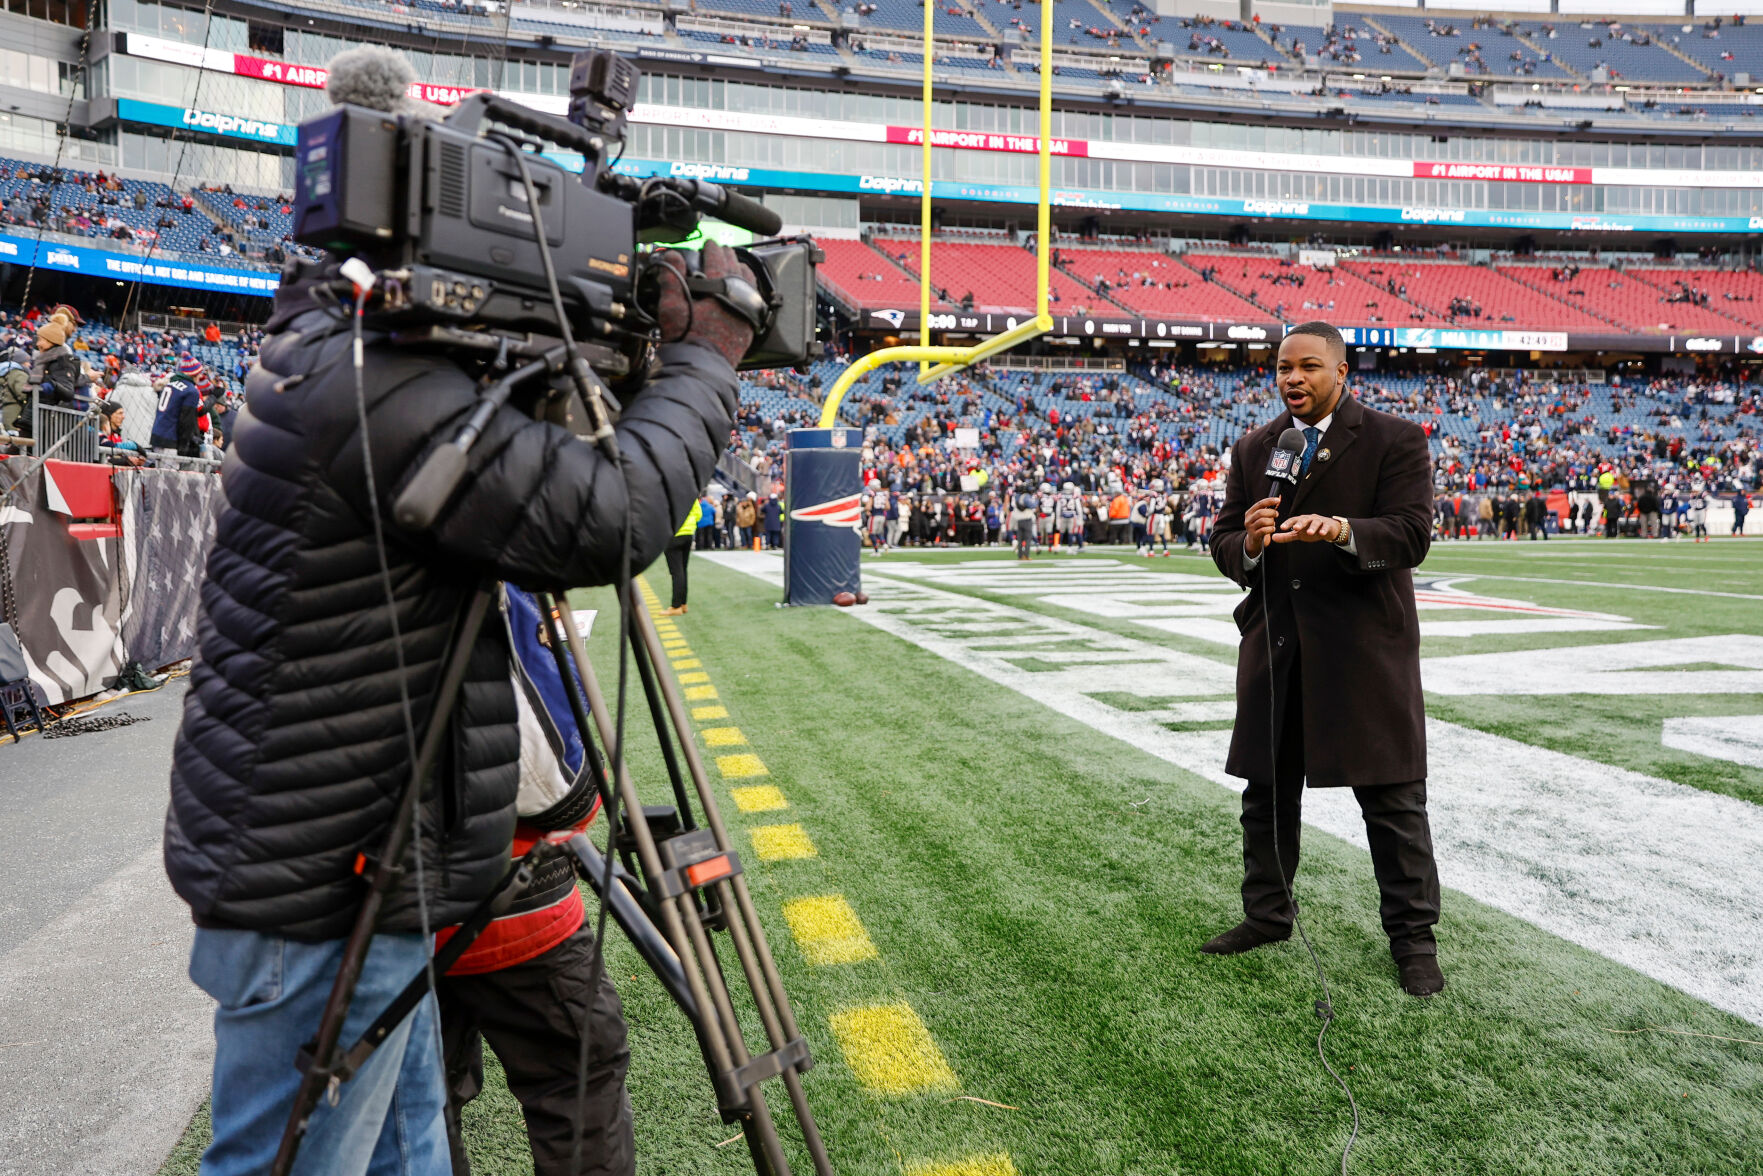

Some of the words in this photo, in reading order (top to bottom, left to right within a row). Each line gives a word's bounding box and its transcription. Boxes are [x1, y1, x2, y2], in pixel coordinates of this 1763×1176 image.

[263, 63, 282, 79] #1
[286, 67, 328, 85] AIRP
[183, 109, 278, 137] Dolphins
[908, 130, 924, 143] #1
[928, 131, 985, 147] AIRPORT
[989, 136, 1004, 149] IN
[1007, 137, 1033, 150] THE
[670, 162, 749, 181] Dolphins
[1432, 164, 1446, 176] #1
[1448, 165, 1500, 179] AIRPORT
[1503, 167, 1517, 179] IN
[1519, 168, 1542, 180] THE
[1545, 169, 1574, 182] USA!
[1243, 199, 1309, 216] Dolphins
[1401, 207, 1465, 223] Dolphins
[106, 258, 121, 272] THE
[1085, 320, 1094, 334] 0
[1157, 323, 1166, 337] 0
[1370, 329, 1380, 344] 0
[1441, 331, 1467, 346] MIA
[1273, 458, 1288, 468] NFL
